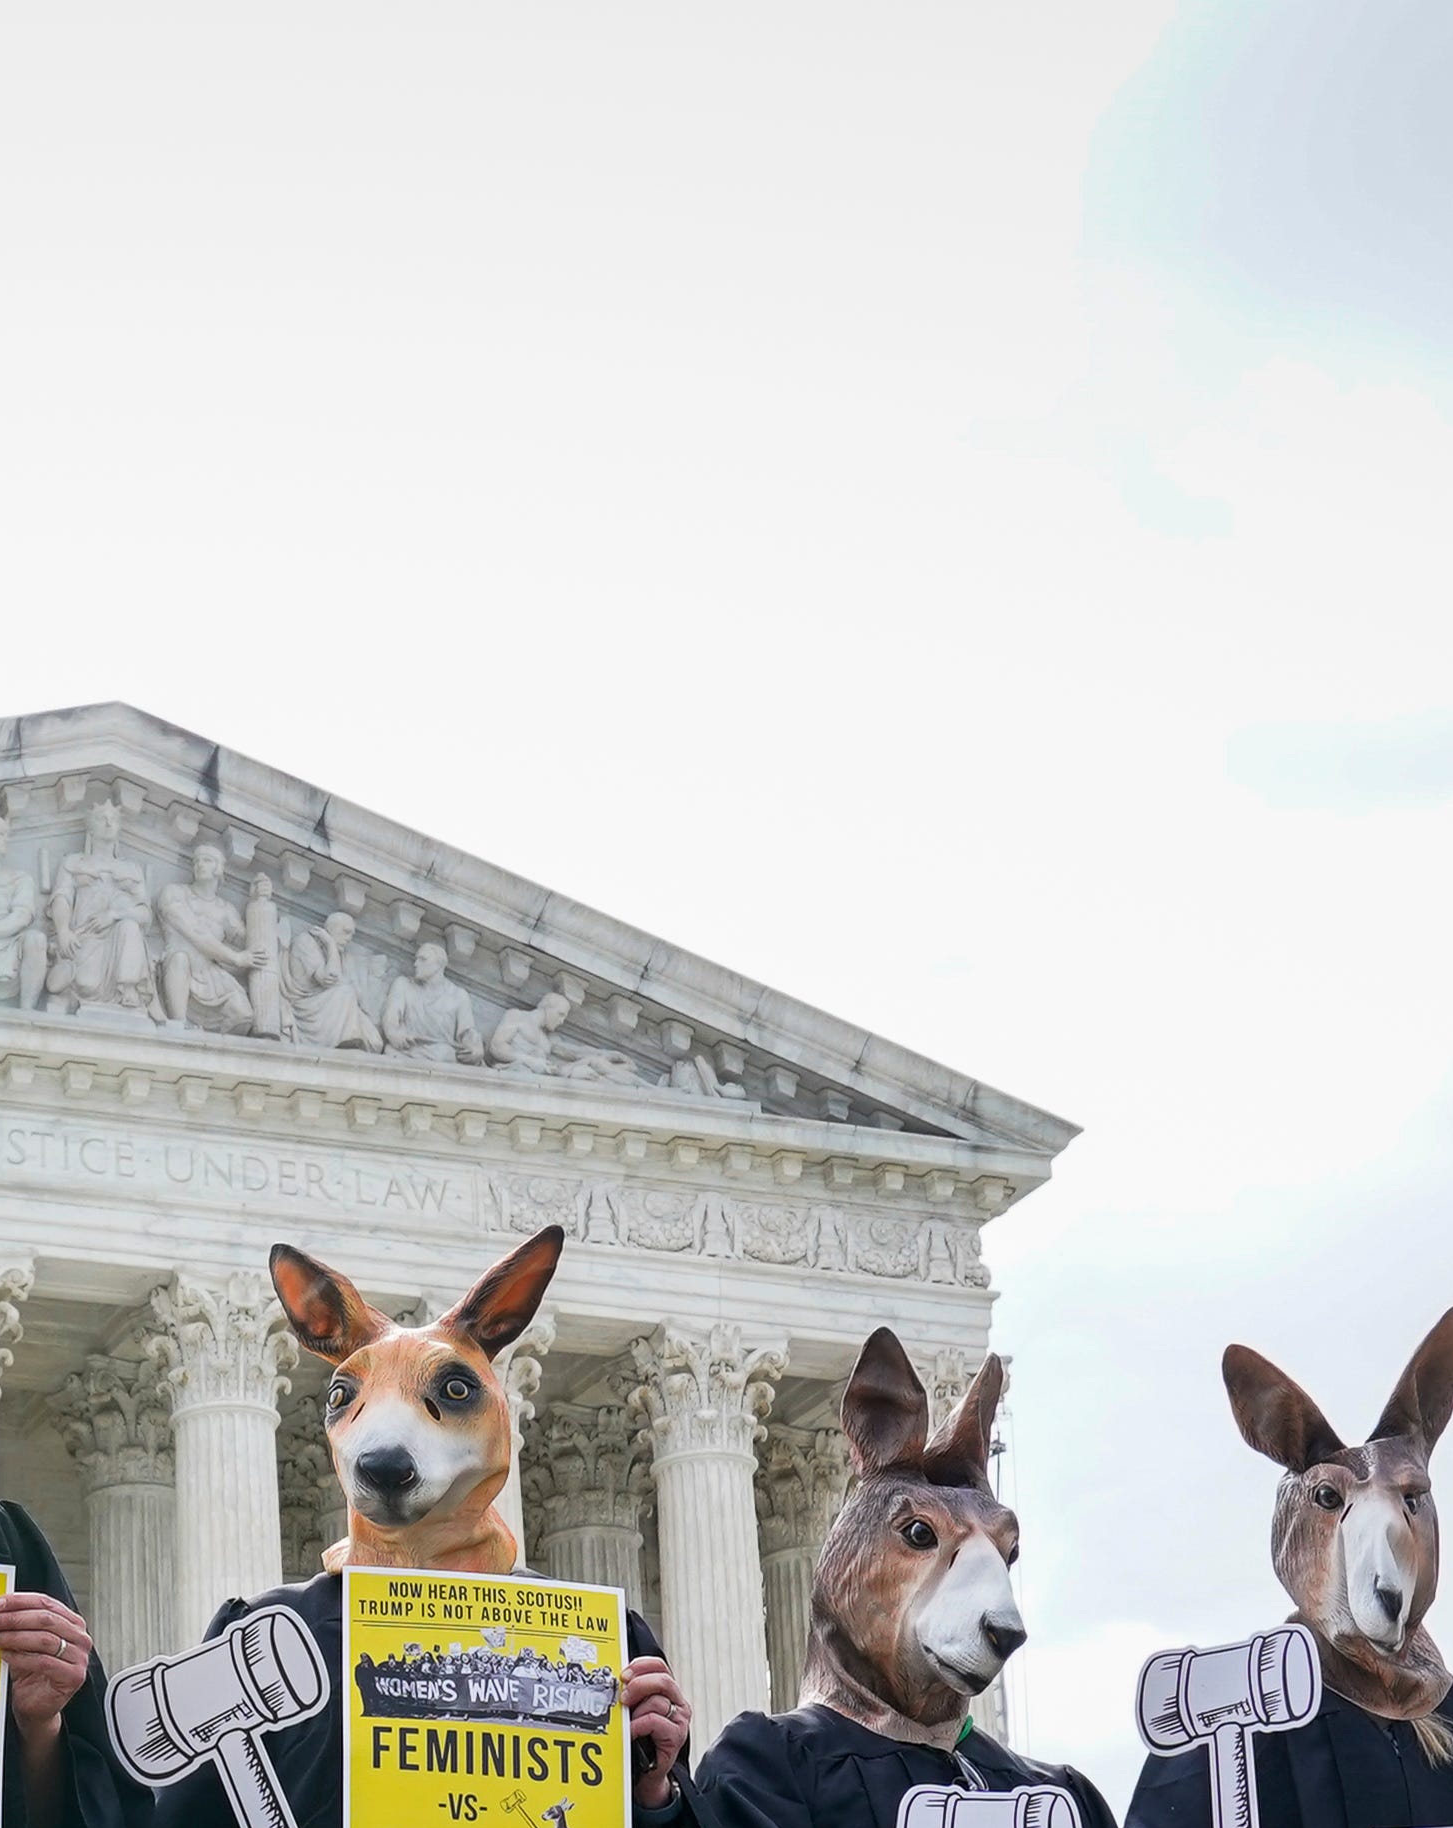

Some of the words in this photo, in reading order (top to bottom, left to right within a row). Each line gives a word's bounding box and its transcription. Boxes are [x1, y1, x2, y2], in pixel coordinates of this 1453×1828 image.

[164, 1146, 342, 1201] UNDER
[354, 1169, 450, 1213] LAW
[389, 1582, 422, 1598] NOW
[429, 1584, 467, 1601] HEAR
[473, 1587, 511, 1606] THIS,
[517, 1590, 581, 1611] SCOTUS!!
[359, 1600, 413, 1616] TRUMP
[422, 1603, 435, 1618] IS
[444, 1604, 473, 1619] NOT
[481, 1607, 532, 1624] ABOVE
[540, 1612, 569, 1628] THE
[577, 1616, 607, 1632] LAW
[375, 1676, 456, 1702] WOMEN'S
[468, 1677, 520, 1704] WAVE
[533, 1684, 606, 1716] RISING
[373, 1725, 602, 1786] FEMINISTS
[439, 1793, 487, 1821] -VS-
